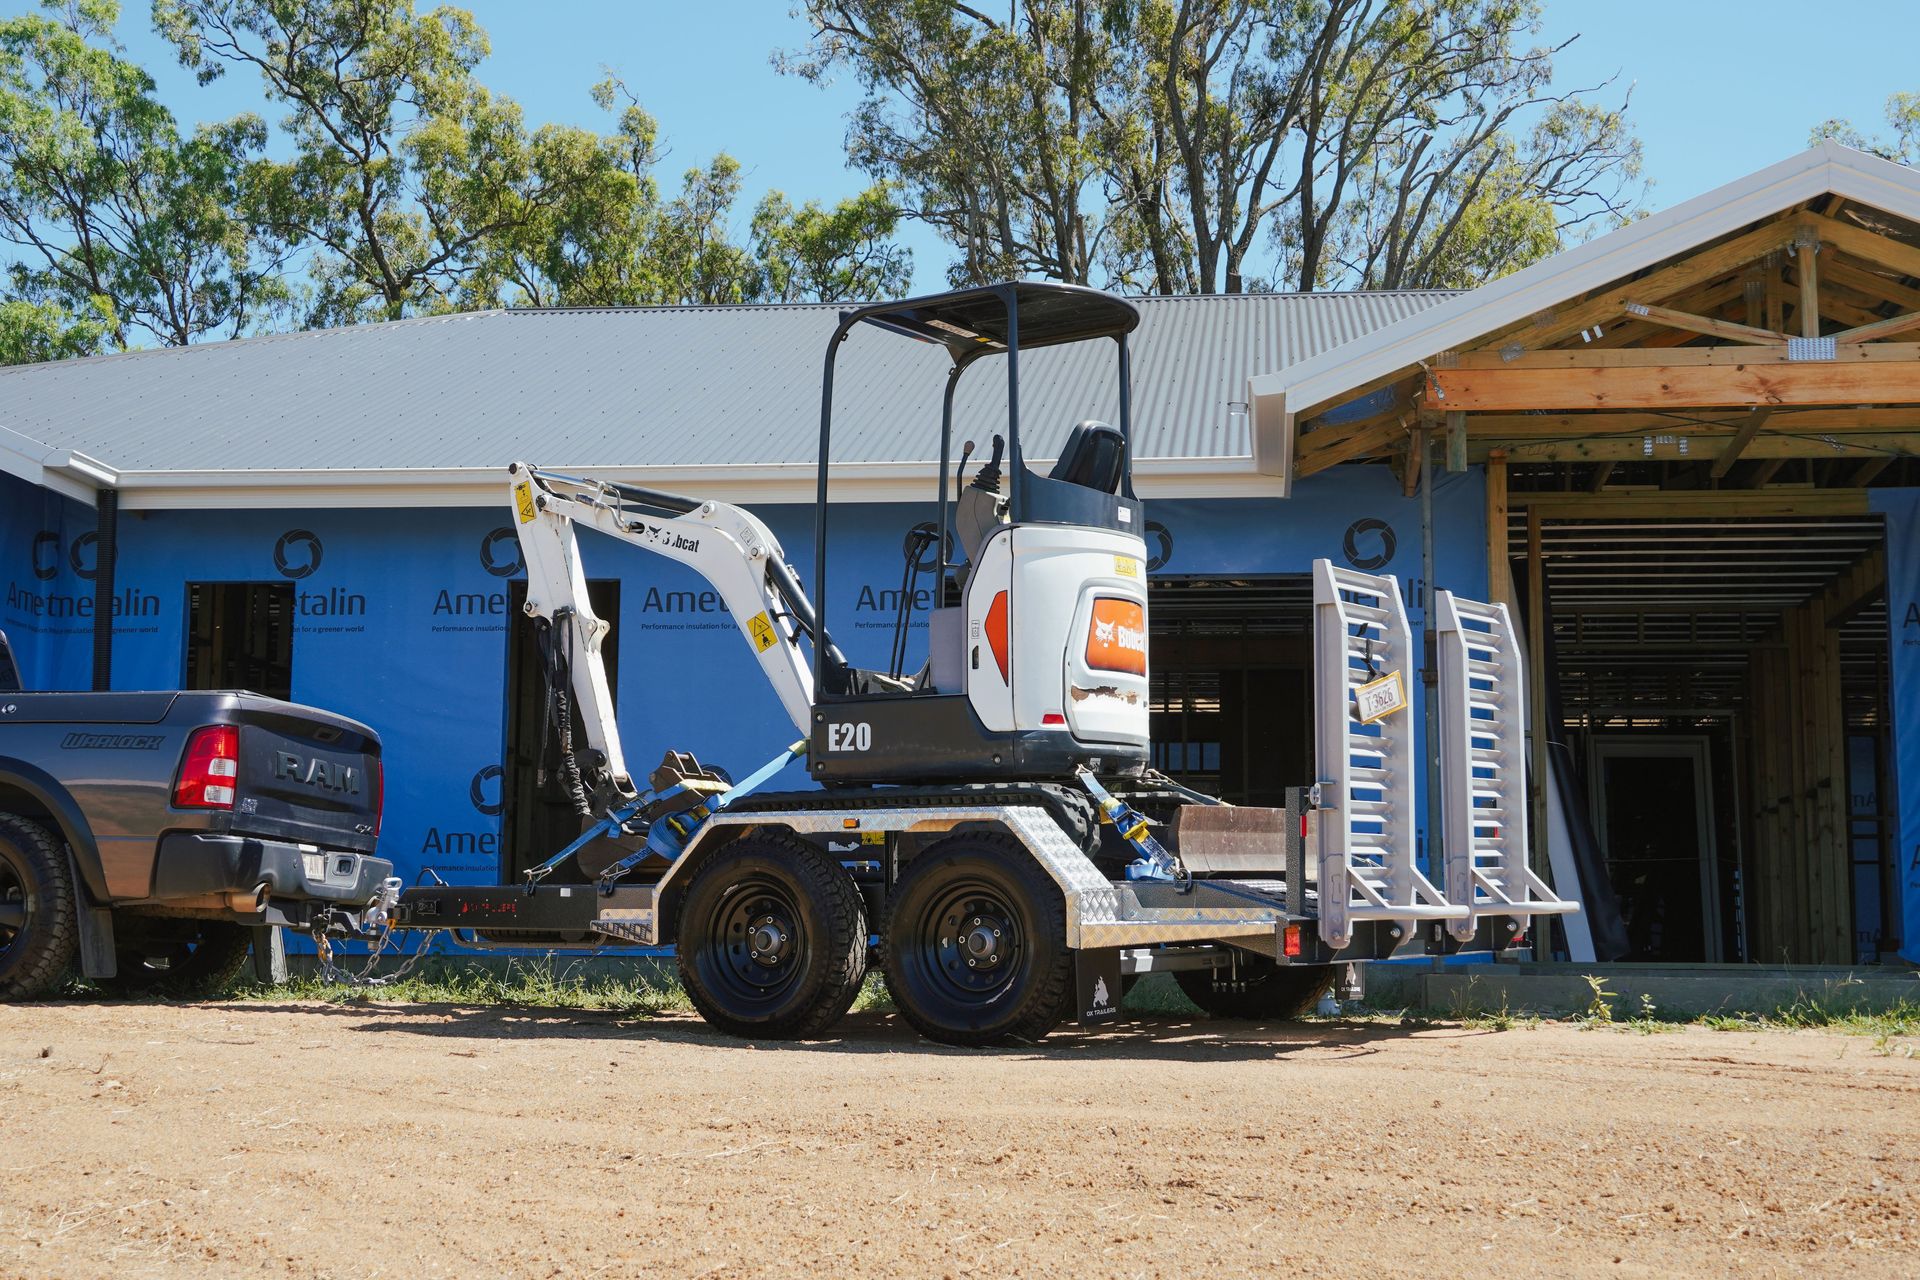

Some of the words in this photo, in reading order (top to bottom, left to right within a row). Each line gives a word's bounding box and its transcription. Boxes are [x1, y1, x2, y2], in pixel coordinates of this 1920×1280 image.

[294, 587, 366, 616] talin
[431, 625, 475, 633] Performance
[641, 622, 685, 631] Performance
[686, 622, 720, 631] insulation
[60, 732, 167, 750] WARLOCK
[828, 722, 872, 752] E20
[275, 750, 361, 795] RAM
